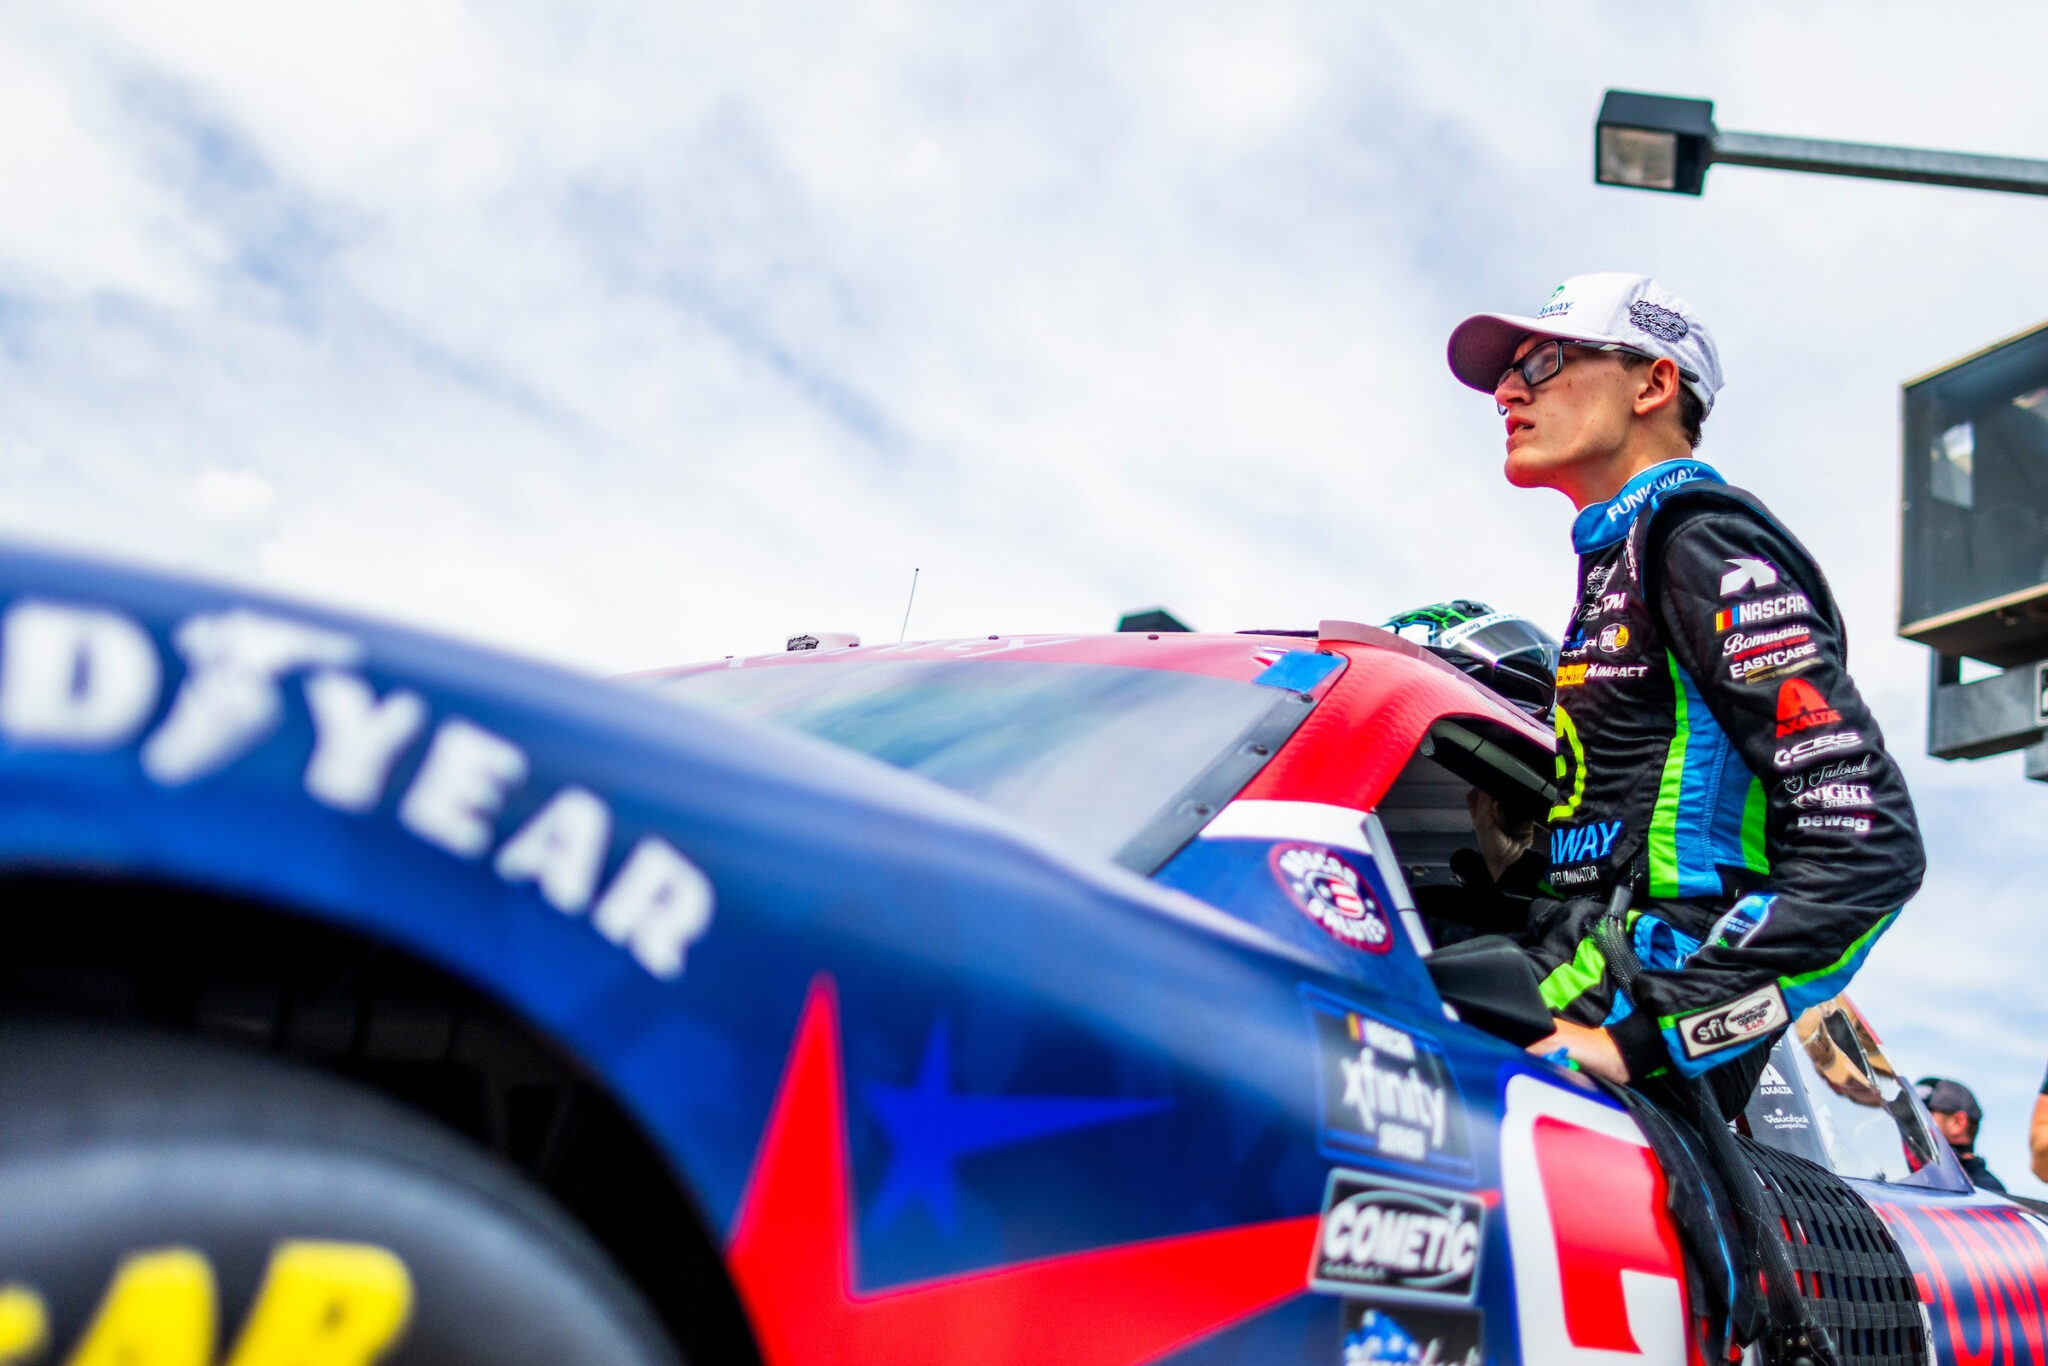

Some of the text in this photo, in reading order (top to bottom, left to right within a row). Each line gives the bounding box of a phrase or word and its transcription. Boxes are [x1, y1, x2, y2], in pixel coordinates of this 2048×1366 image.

[1739, 594, 1810, 623] NASCAR
[1722, 624, 1810, 657] Bommarito
[1596, 665, 1649, 679] IMPACT
[1729, 642, 1818, 679] EASYCARE
[1775, 708, 1843, 739] AXALTA
[1808, 753, 1871, 788] Tailored
[1551, 820, 1623, 864] WAY
[1696, 1017, 1727, 1042] sfi
[1760, 1086, 1794, 1096] AXALTA
[1321, 1201, 1479, 1276] COMETIC
